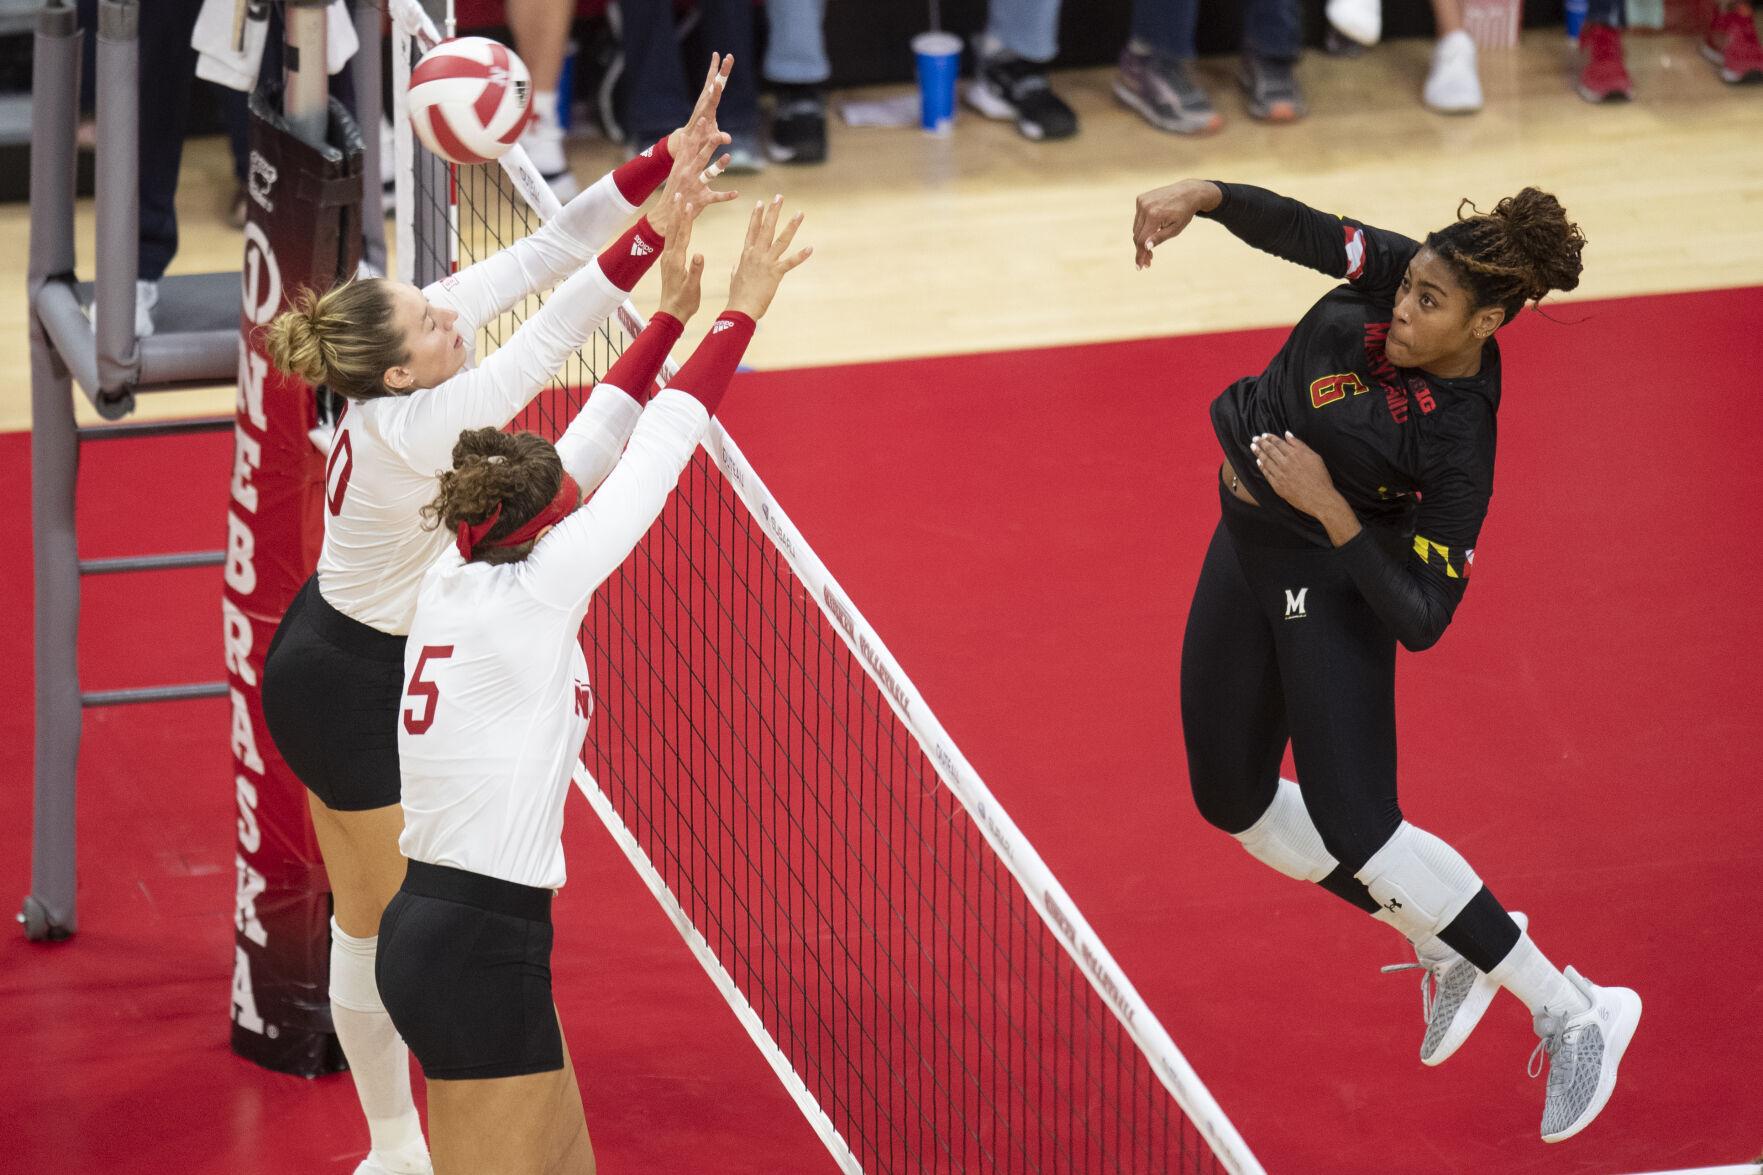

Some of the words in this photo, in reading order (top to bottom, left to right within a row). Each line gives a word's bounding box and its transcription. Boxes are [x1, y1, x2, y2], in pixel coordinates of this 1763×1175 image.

[1310, 371, 1370, 409] 6
[222, 330, 269, 1035] NEBRASKA
[403, 644, 455, 735] 5
